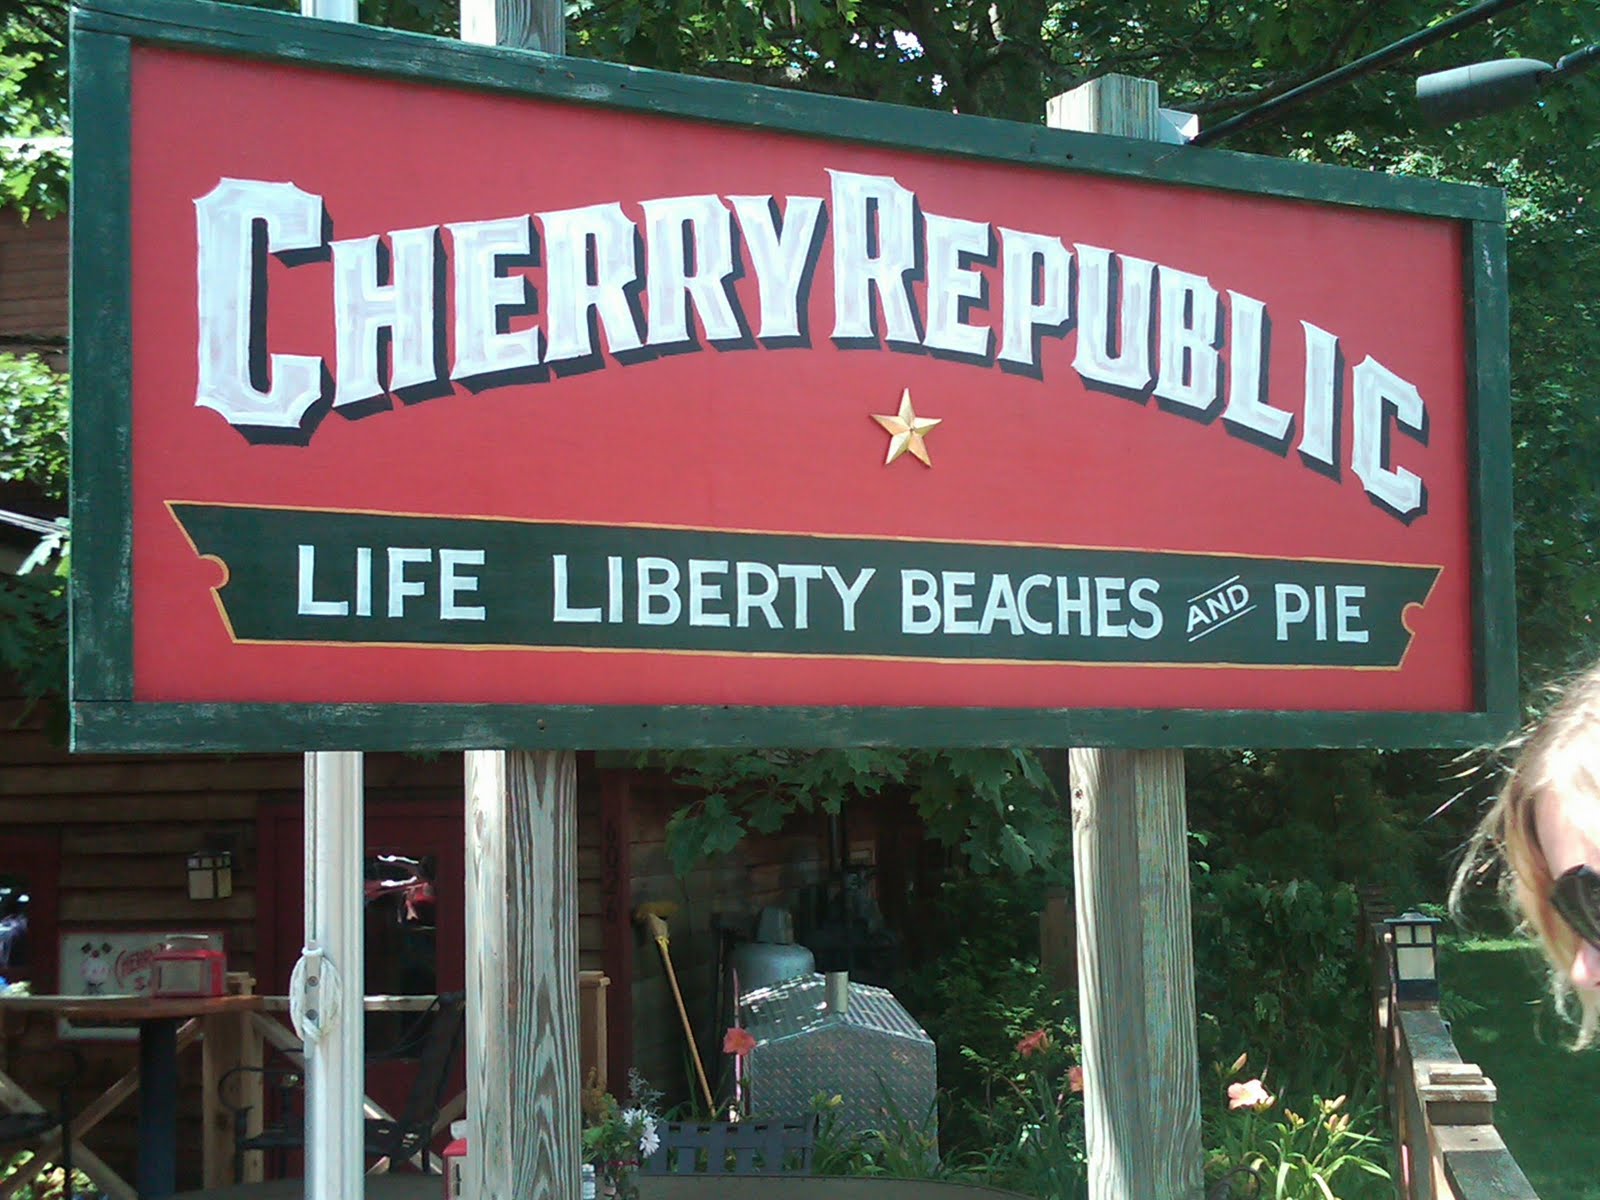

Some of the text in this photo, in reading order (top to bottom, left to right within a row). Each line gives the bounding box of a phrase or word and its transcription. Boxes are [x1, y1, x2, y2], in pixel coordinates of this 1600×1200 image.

[297, 544, 1369, 643] LIFE LIBERTY BEACHES AND PIE
